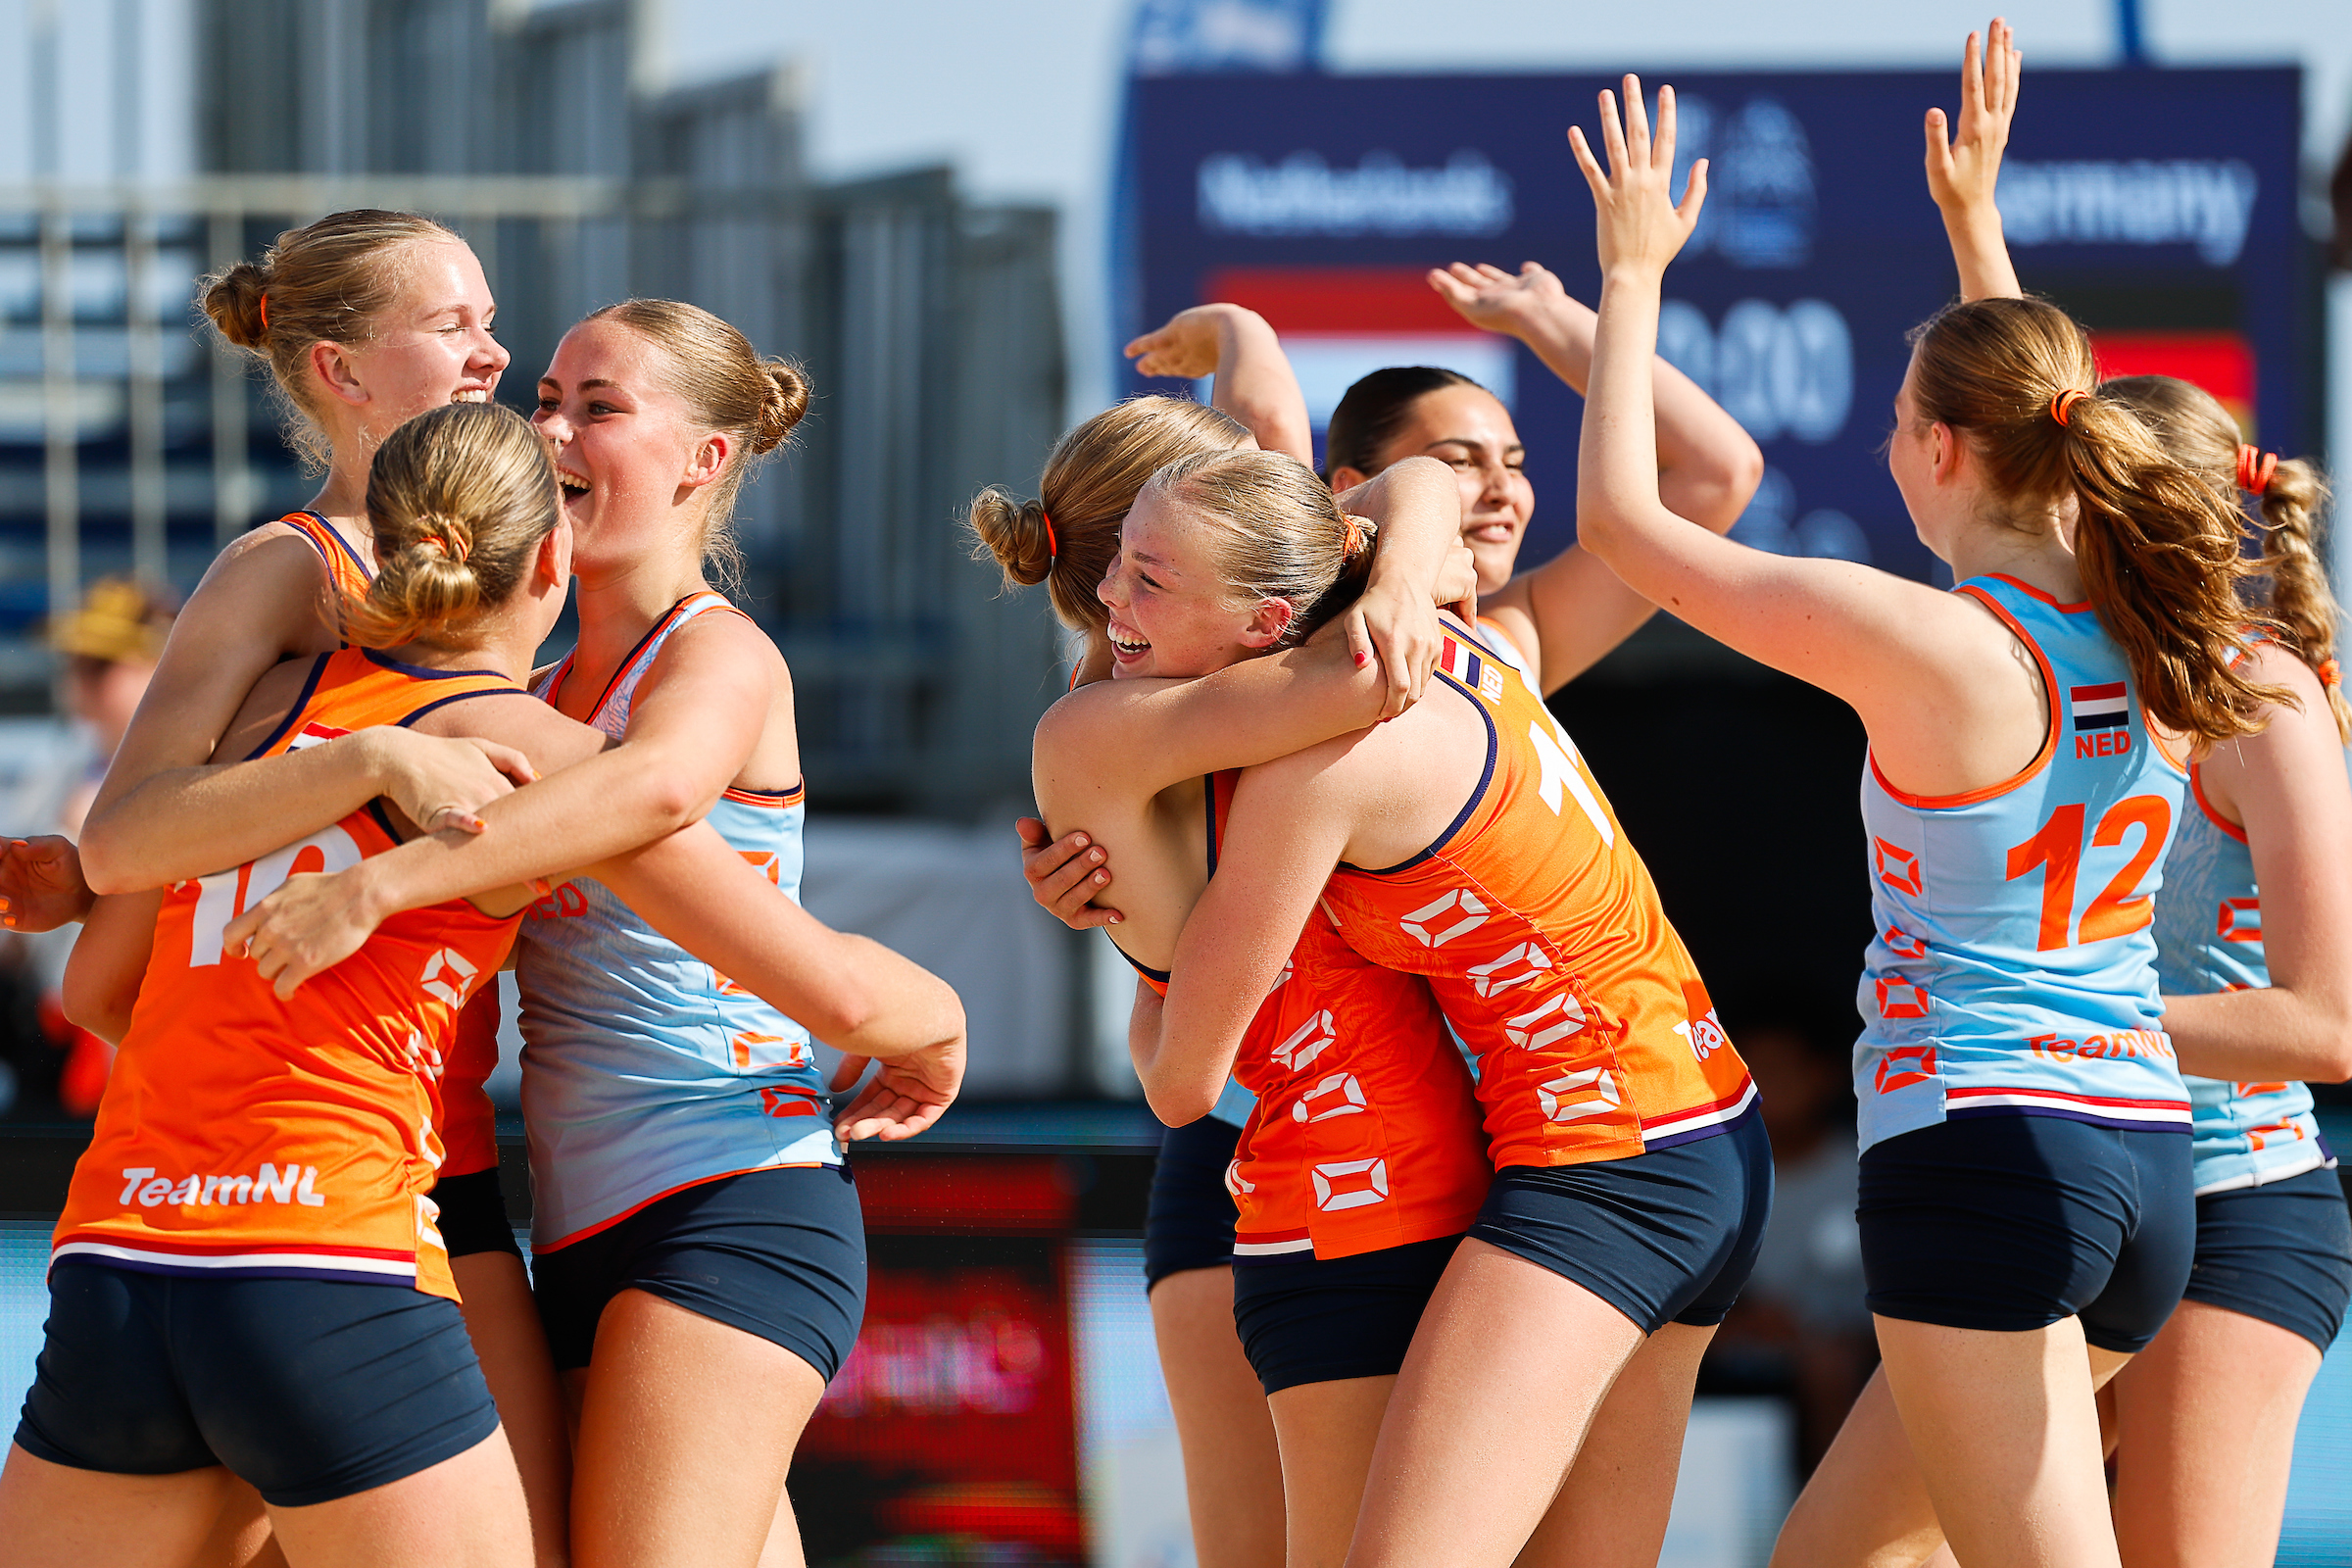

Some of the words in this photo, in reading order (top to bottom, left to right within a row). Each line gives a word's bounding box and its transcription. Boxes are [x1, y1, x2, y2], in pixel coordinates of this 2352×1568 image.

[1995, 158, 2258, 267] ermany
[1480, 663, 1504, 706] NED
[2074, 731, 2132, 760] NED
[2005, 794, 2172, 953] 12
[2022, 1029, 2175, 1064] TeamNL
[119, 1162, 325, 1207] TeamNL
